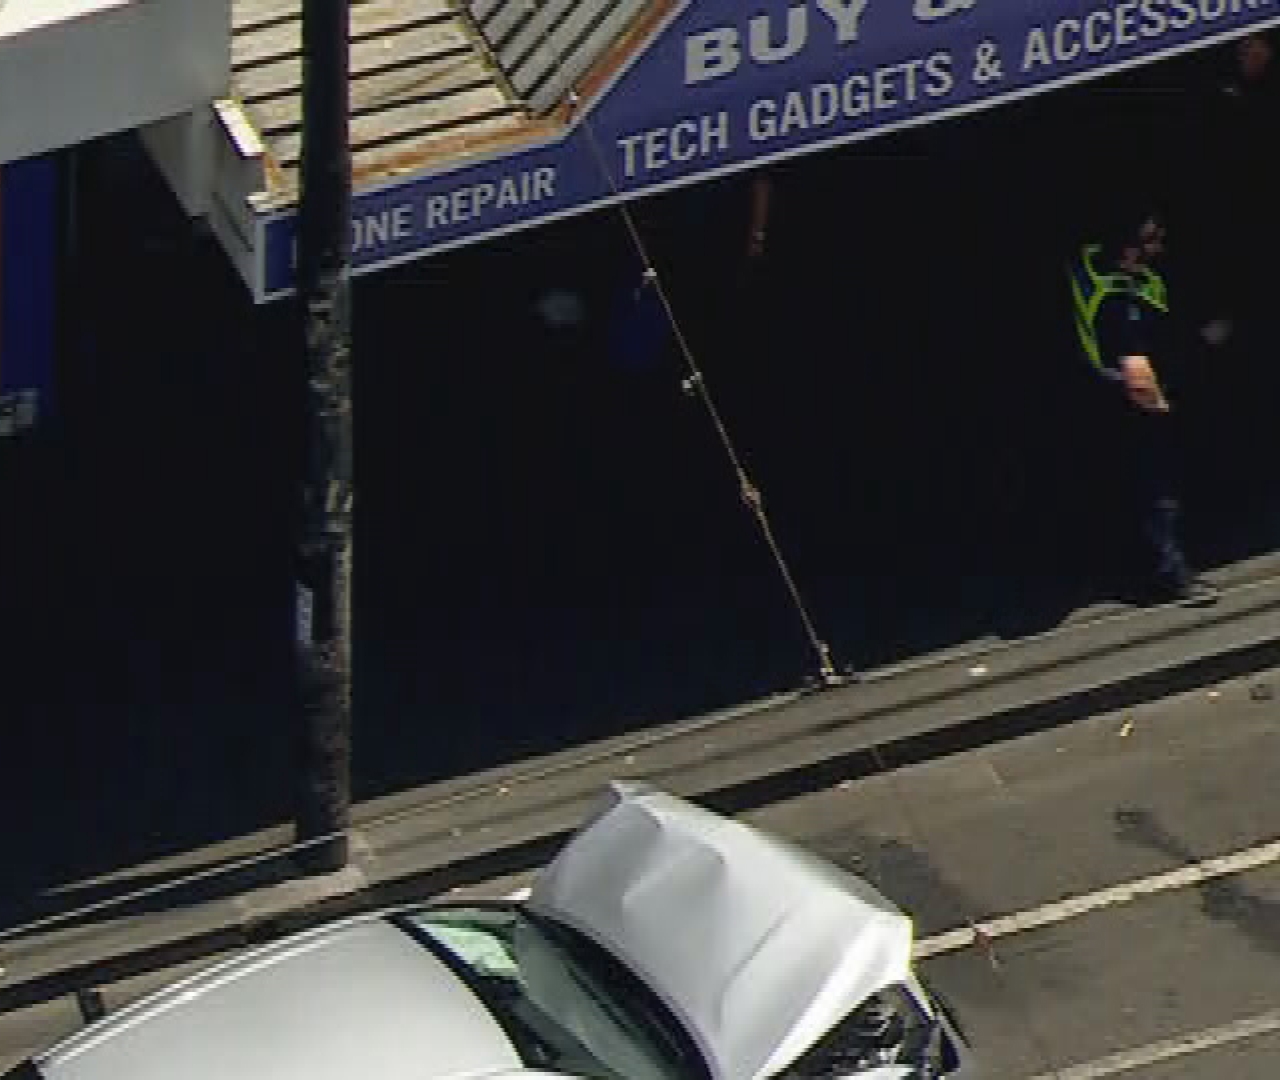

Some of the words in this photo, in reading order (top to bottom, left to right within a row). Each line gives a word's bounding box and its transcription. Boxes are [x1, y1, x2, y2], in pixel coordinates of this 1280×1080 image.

[685, 0, 867, 84] BUY
[617, 111, 729, 177] TECH
[748, 51, 953, 141] GADGETS
[972, 39, 1003, 84] &
[1023, 0, 1271, 72] ACCESSO
[426, 167, 556, 229] REPAIR
